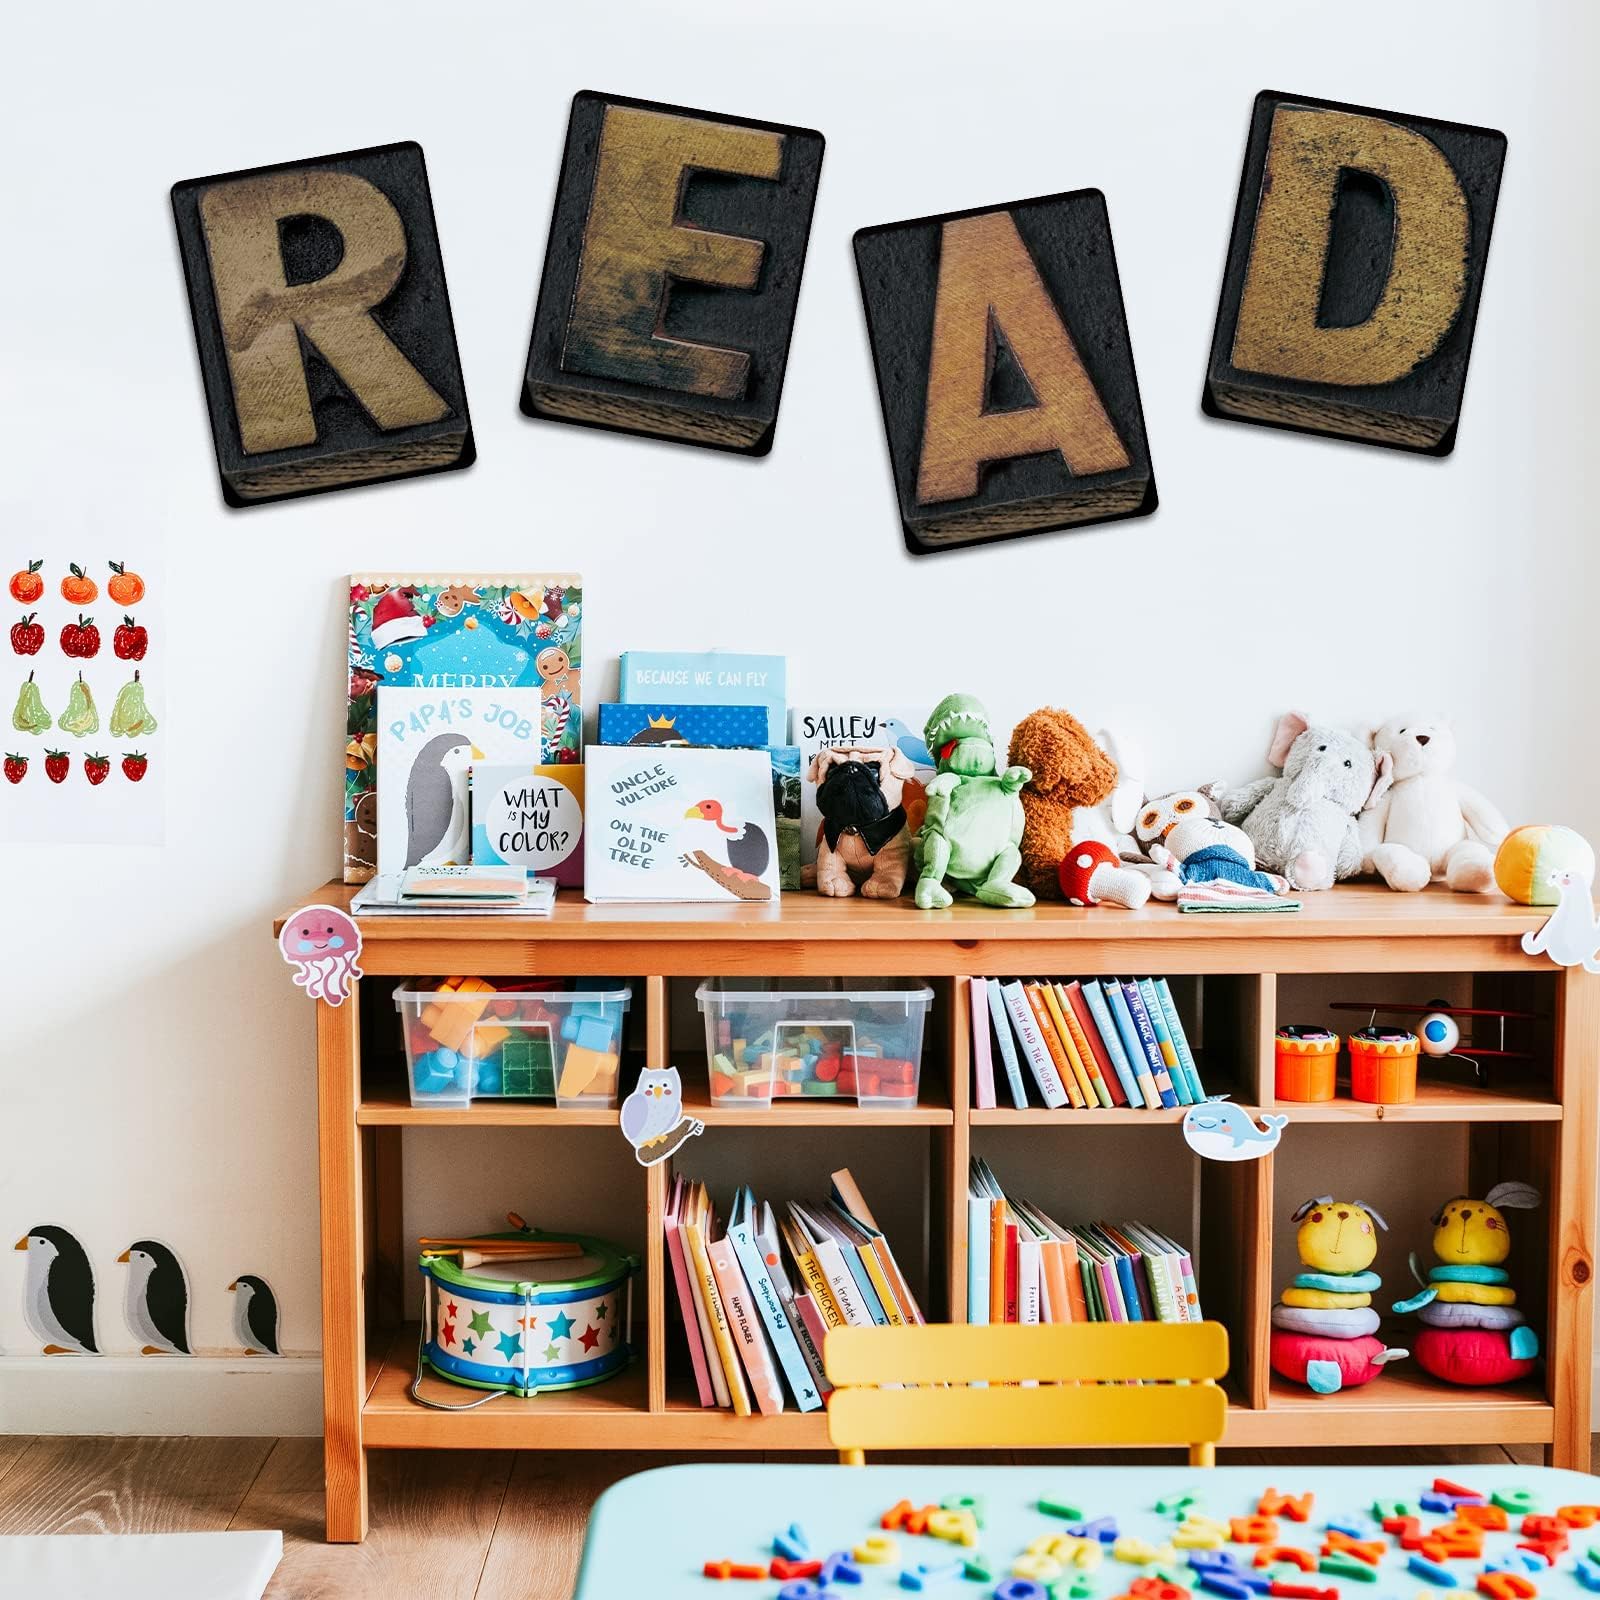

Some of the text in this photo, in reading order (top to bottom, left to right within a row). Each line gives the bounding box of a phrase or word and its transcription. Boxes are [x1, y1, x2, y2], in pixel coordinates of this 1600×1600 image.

[636, 670, 769, 687] BECAUSE WE CAN FLY
[389, 698, 533, 742] PAPA'S JOB
[803, 715, 877, 739] SALLEY
[611, 763, 667, 795] UNCLE
[615, 775, 678, 807] VULTURE
[503, 787, 564, 808] WHAT
[521, 810, 551, 831] MY
[609, 819, 669, 844] ON THE
[499, 831, 569, 852] COLOR?
[617, 836, 652, 854] OLD
[609, 847, 655, 869] TREE
[1140, 984, 1162, 1025] SUMMER
[1130, 996, 1144, 1016] THE
[1137, 1014, 1153, 1042] MAGIC
[1009, 997, 1028, 1024] JENNY
[1022, 1027, 1036, 1045] AND
[1030, 1047, 1045, 1064] THE
[1038, 1066, 1057, 1095] HORSE
[803, 1259, 842, 1328] THE CHICKEN
[737, 1317, 754, 1344] FLOWER
